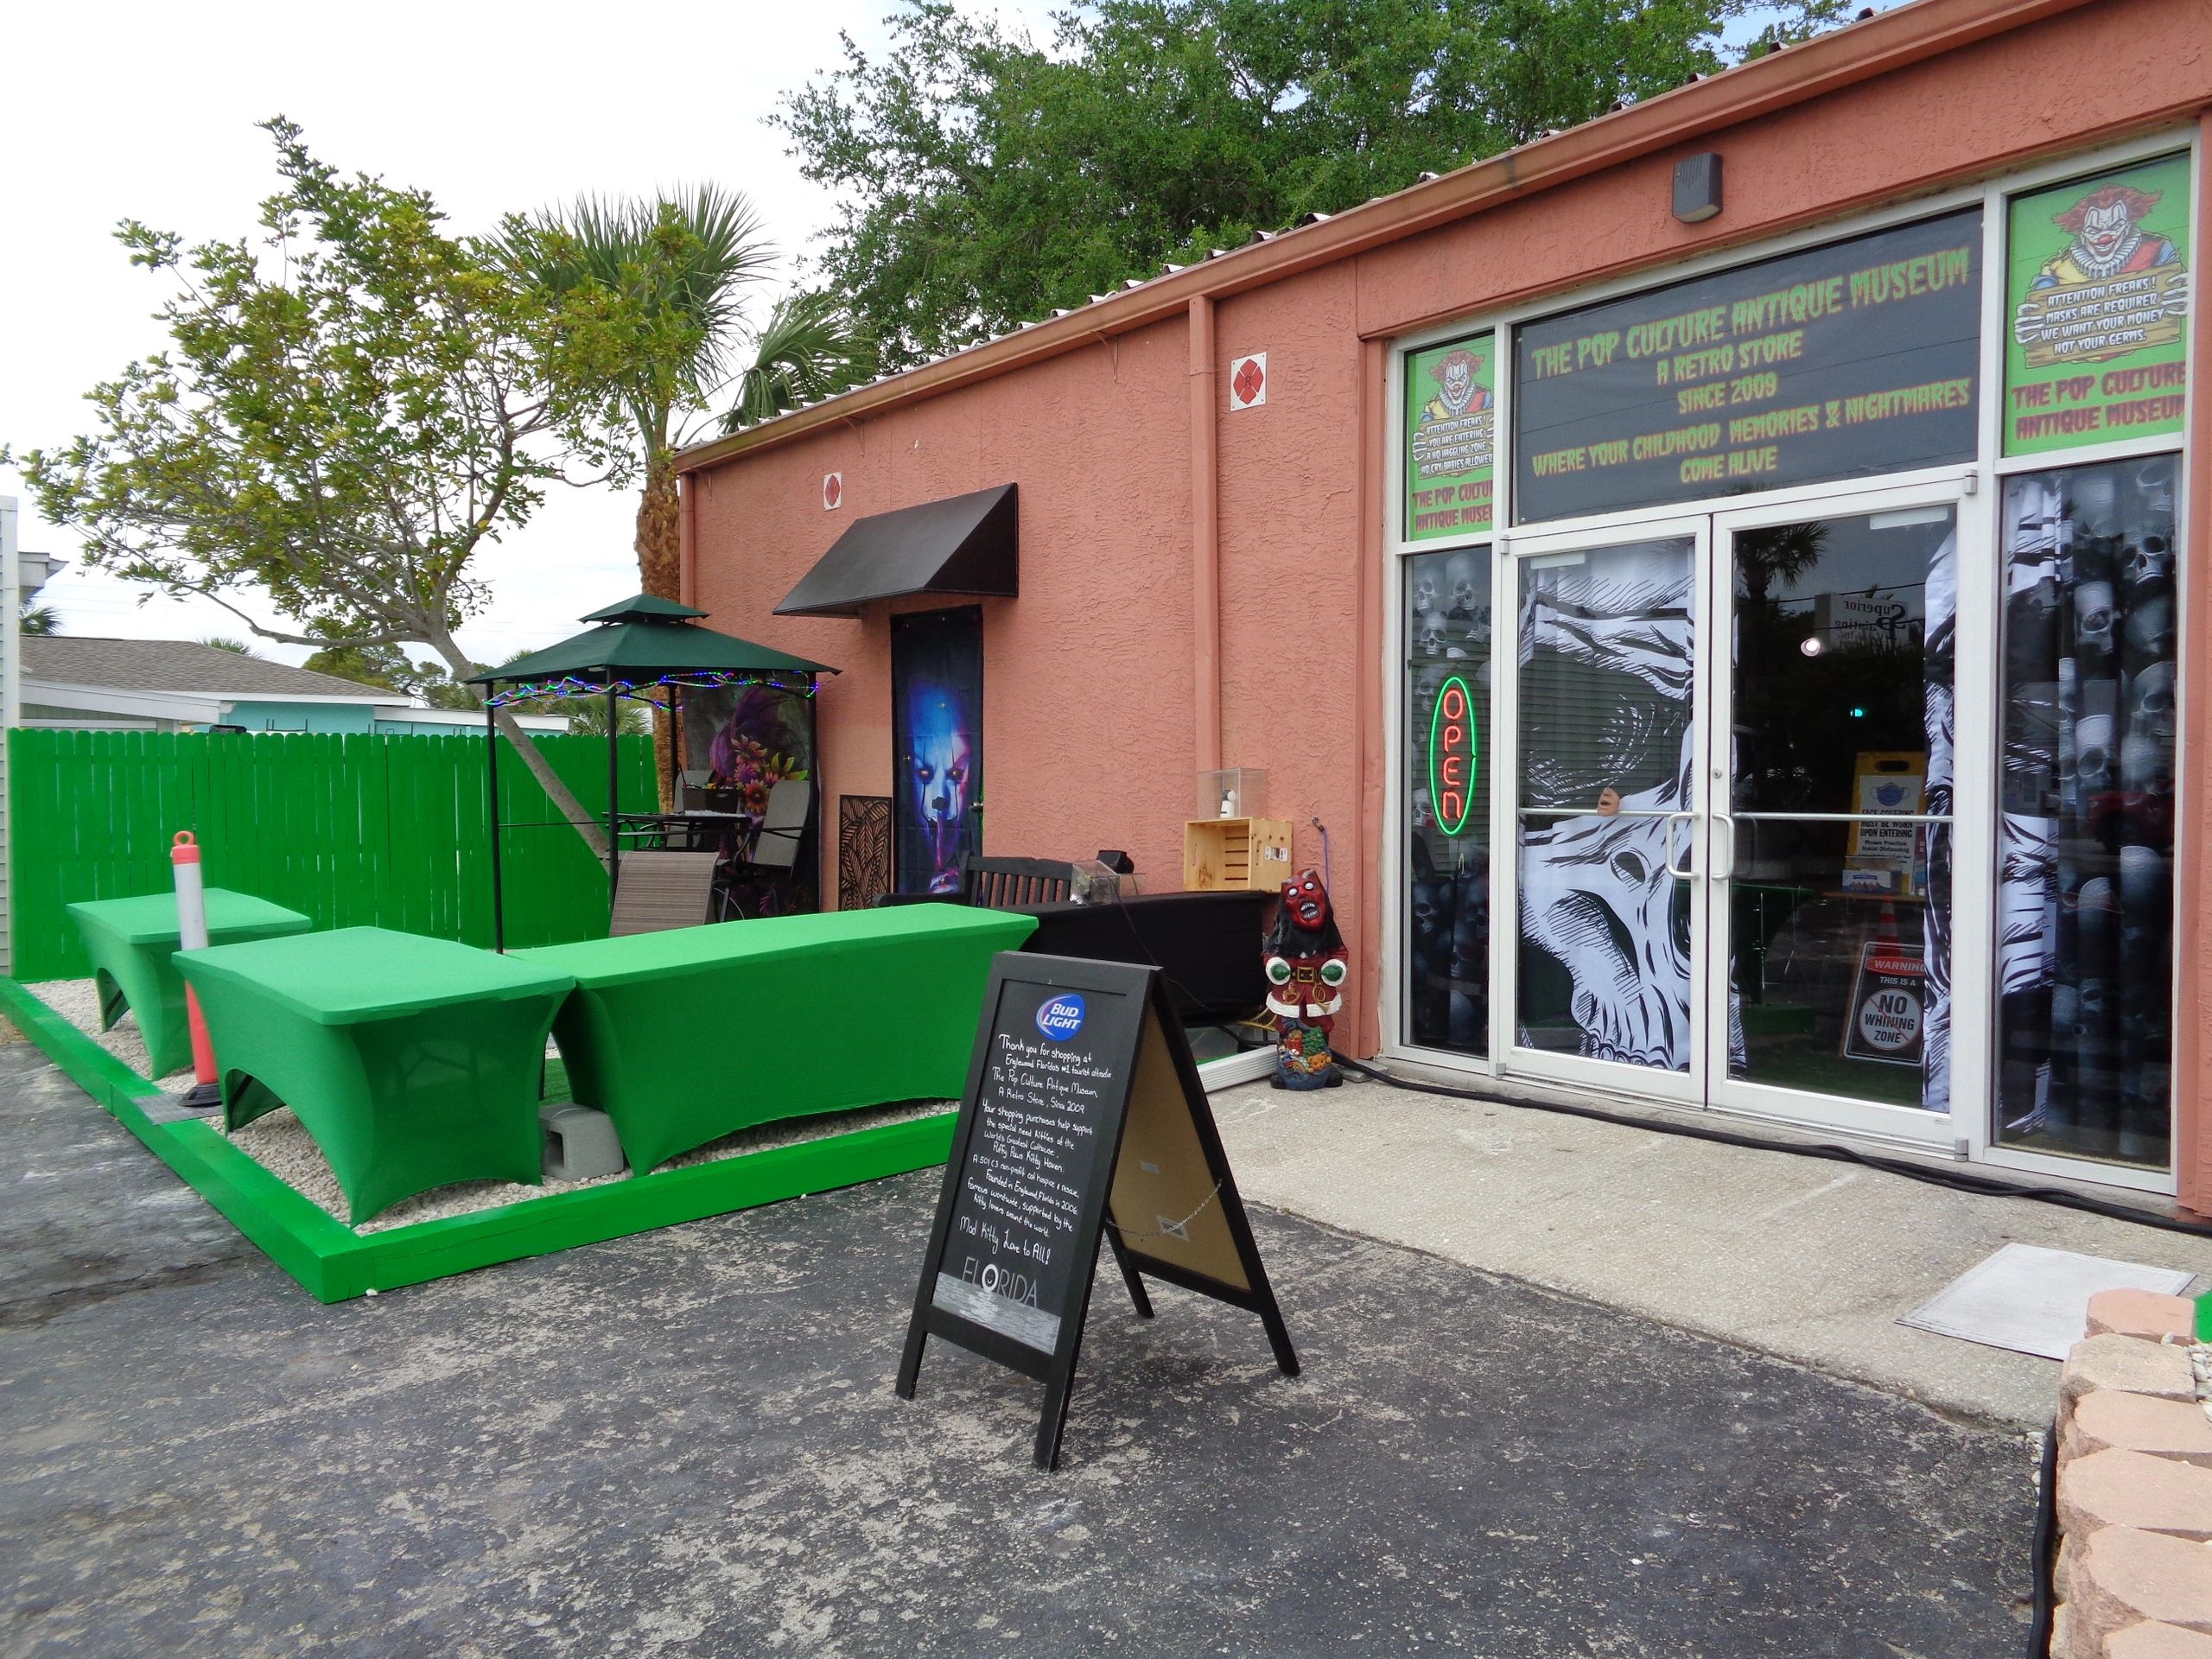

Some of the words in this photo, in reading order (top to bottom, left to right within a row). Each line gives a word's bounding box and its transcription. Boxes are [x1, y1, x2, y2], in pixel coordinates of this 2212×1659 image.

[2047, 286, 2106, 308] ATTENTION
[2108, 276, 2150, 295] FREAKS
[1531, 345, 1573, 379] THE
[1577, 332, 1619, 370] POP
[1626, 306, 1726, 359] CULTURE
[1732, 277, 1843, 334] ANTIQUE
[1849, 247, 1970, 308] MUSEUM
[2046, 308, 2078, 324] MASKS
[2080, 303, 2101, 317] ARE
[2104, 293, 2158, 313] REQUIRED
[2041, 327, 2059, 340] WE
[2062, 321, 2093, 338] WANT
[2095, 315, 2125, 330] YOUR
[2127, 308, 2164, 325] MONEY
[2054, 340, 2075, 355] NOT
[2078, 335, 2106, 350] YOUR
[2108, 329, 2146, 346] GERMS.
[1656, 362, 1668, 385] A
[1673, 345, 1733, 380] RETRO
[1738, 331, 1803, 368] STORE
[1677, 383, 1726, 414] SINCE
[1730, 372, 1778, 404] 2009
[2012, 381, 2051, 410] THE
[2055, 375, 2096, 404] POP
[1426, 420, 1459, 435] ATTENTION
[1428, 437, 1440, 448] YOU
[1442, 435, 1453, 445] ARE
[1454, 428, 1484, 442] ENTERING
[1533, 448, 1586, 479] WHERE
[1589, 439, 1628, 467] YOUR
[1632, 423, 1720, 461] CHILDHOOD
[1729, 404, 1819, 442] MEMORIES
[1825, 401, 1840, 428] &
[1845, 378, 1971, 424] NIGHTMARES
[2015, 405, 2101, 441] ANTIQUE
[1421, 465, 1429, 474] NO
[1431, 462, 1442, 474] CRY
[1443, 458, 1464, 471] BABIES
[1432, 449, 1440, 461] NO
[1441, 444, 1469, 458] HAGGLING
[1680, 454, 1724, 484] COME
[1728, 445, 1777, 474] ALIVE
[1413, 490, 1433, 508] THE
[1434, 486, 1456, 505] POP
[1415, 508, 1459, 531] ANTIQUE
[1860, 828, 1878, 837] UPON
[1879, 829, 1912, 838] ENTERING
[1880, 976, 1898, 985] THIS
[1050, 1003, 1079, 1017] BUD
[1878, 995, 1908, 1015] NO
[1042, 1014, 1081, 1030] LIGHT
[1865, 1014, 1915, 1031] WHINING
[1873, 1030, 1901, 1044] ZONE
[998, 1033, 1024, 1052] Thank
[1026, 1046, 1037, 1058] you
[1039, 1043, 1050, 1056] for
[1051, 1048, 1081, 1066] shopping
[1083, 1052, 1092, 1063] at
[992, 1066, 1004, 1082] The
[1008, 1069, 1018, 1086] Pop
[1020, 1072, 1043, 1088] Culture
[1046, 1077, 1069, 1096] Antique
[1071, 1082, 1098, 1098] Museum
[998, 1086, 1004, 1096] A
[1007, 1088, 1024, 1100] Retro
[1051, 1096, 1065, 1110] Since
[1066, 1099, 1084, 1114] 2009
[986, 1116, 995, 1128] the
[997, 1122, 1016, 1133] special
[1018, 1127, 1032, 1137] need
[1057, 1135, 1064, 1146] at
[1065, 1138, 1074, 1150] the
[997, 1106, 1023, 1124] shopping
[1025, 1114, 1055, 1127] purchases
[1058, 1117, 1070, 1131] help
[1072, 1123, 1093, 1136] support
[1006, 1135, 1028, 1149] Greatest
[1010, 1146, 1023, 1160] Paws
[973, 1154, 978, 1163] A
[1027, 1171, 1035, 1180] cat
[1036, 1173, 1055, 1187] hospice
[986, 1168, 1007, 1188] Founded
[1055, 1199, 1060, 1208] in
[988, 1198, 1004, 1215] lovers
[1023, 1217, 1033, 1229] the
[1022, 1202, 1052, 1220] supported
[1053, 1211, 1062, 1230] by
[1063, 1218, 1072, 1232] the
[1002, 1229, 1020, 1254] Love
[1023, 1238, 1031, 1256] to
[1032, 1243, 1051, 1265] All!
